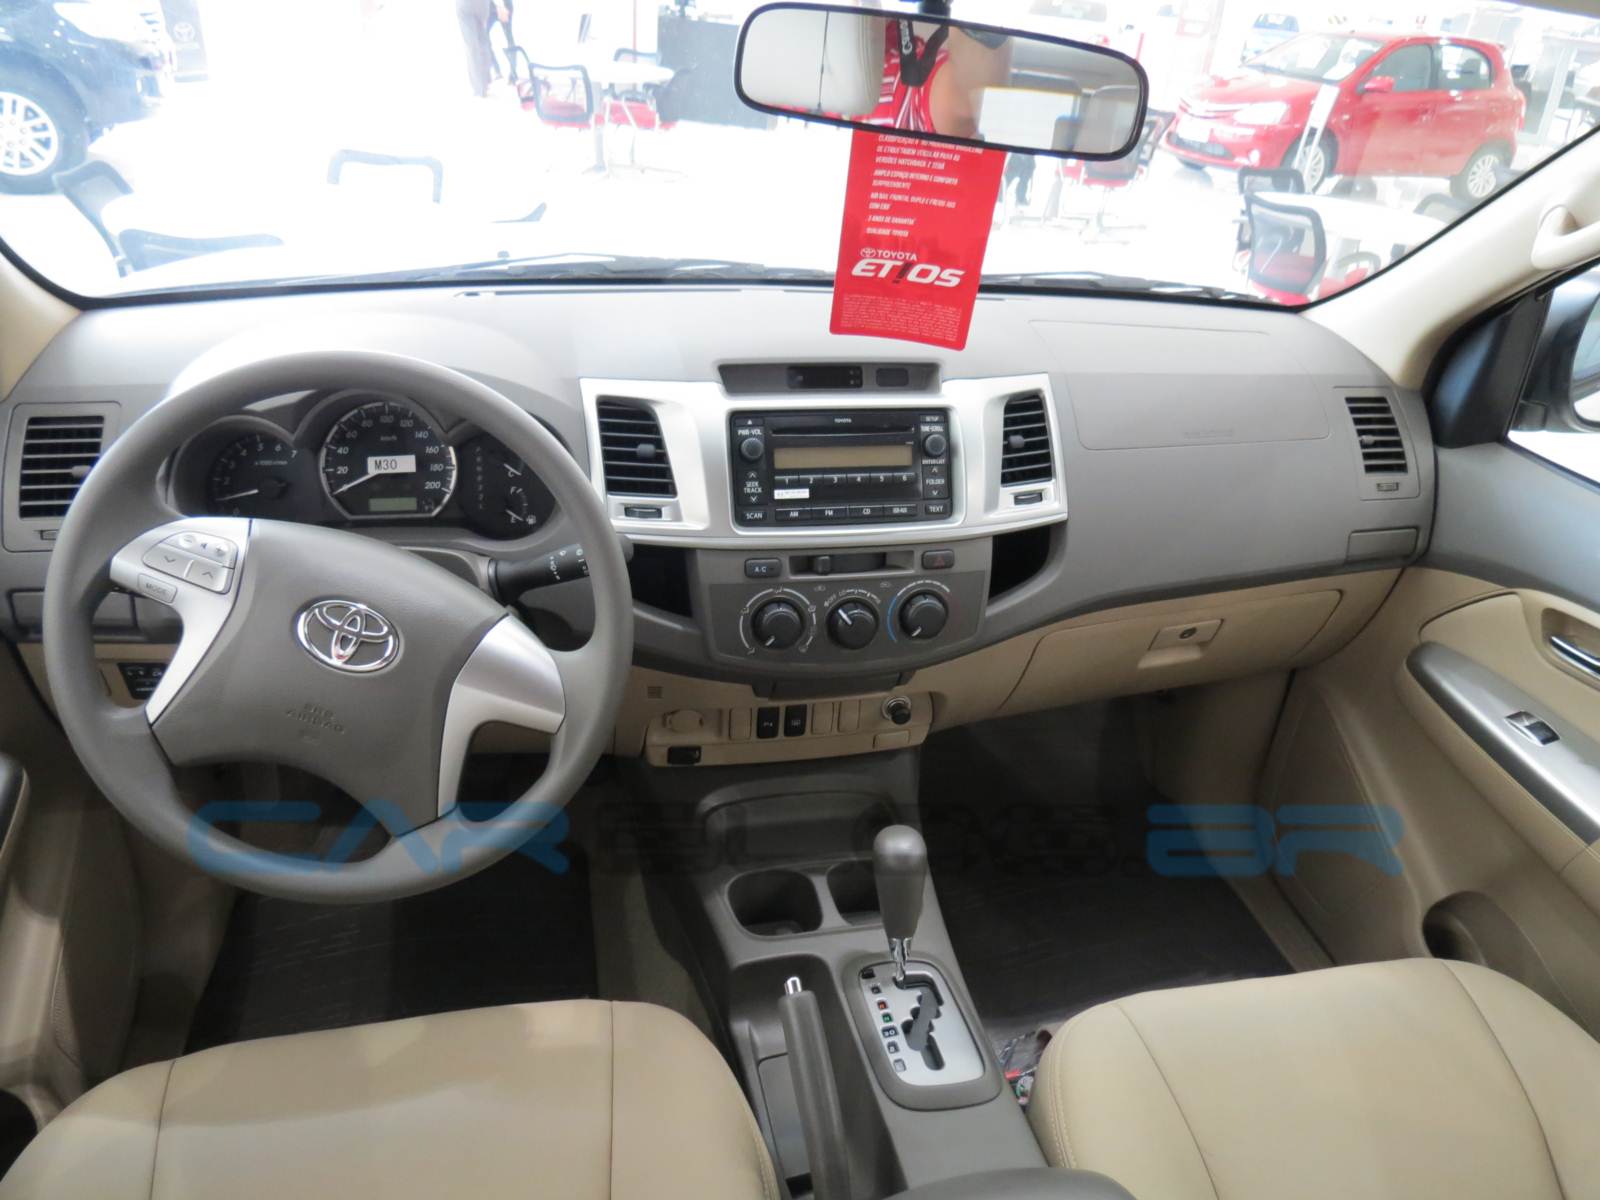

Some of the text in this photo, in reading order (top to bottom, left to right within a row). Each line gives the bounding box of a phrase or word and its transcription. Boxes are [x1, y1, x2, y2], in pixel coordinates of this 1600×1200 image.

[877, 249, 918, 262] TOYOTA
[852, 258, 965, 287] ETIOS
[345, 430, 358, 439] 60
[414, 430, 429, 439] 140
[336, 446, 350, 455] 40
[425, 446, 440, 455] 160
[336, 465, 349, 474] 20
[373, 458, 399, 472] M30
[424, 481, 441, 490] 200
[825, 509, 834, 517] FM
[863, 507, 871, 516] CD
[929, 504, 945, 513] TEXT
[746, 512, 763, 520] SCAN
